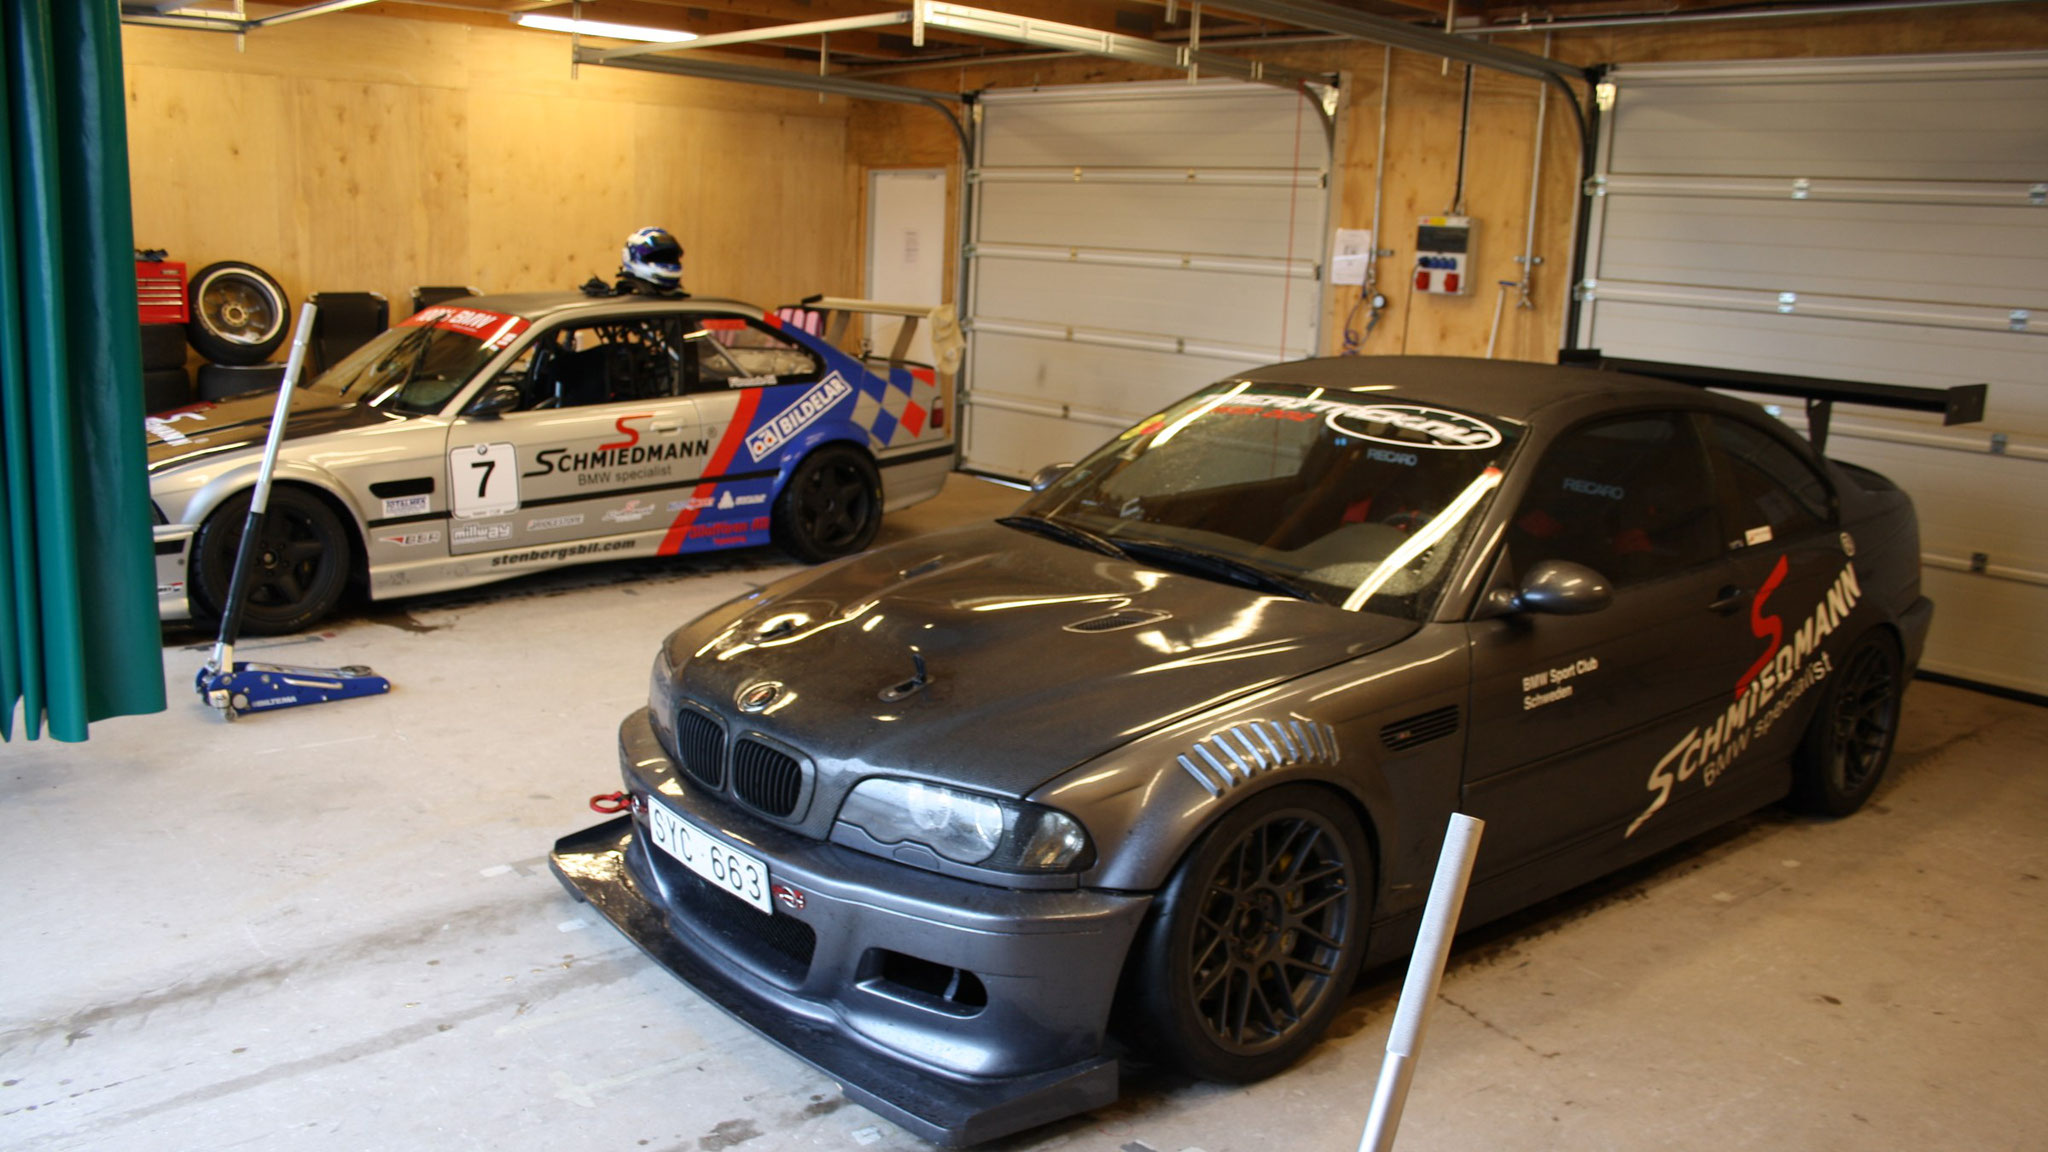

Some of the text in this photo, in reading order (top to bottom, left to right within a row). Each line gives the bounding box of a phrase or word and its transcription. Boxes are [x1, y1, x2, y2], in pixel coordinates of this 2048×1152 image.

[779, 378, 845, 434] BILDELAR
[522, 440, 709, 477] SCHMIEDMANN
[577, 464, 671, 486] BMW specialist
[471, 461, 495, 497] 7
[1563, 478, 1625, 500] RECARO
[454, 522, 510, 542] millway
[491, 539, 636, 567] stenbergsbil.com
[1522, 657, 1599, 692] BMW Sport Club
[1625, 562, 1862, 838] SCHMIEDMANN
[1703, 650, 1834, 787] BMW specialist
[654, 809, 761, 901] SYC 663
